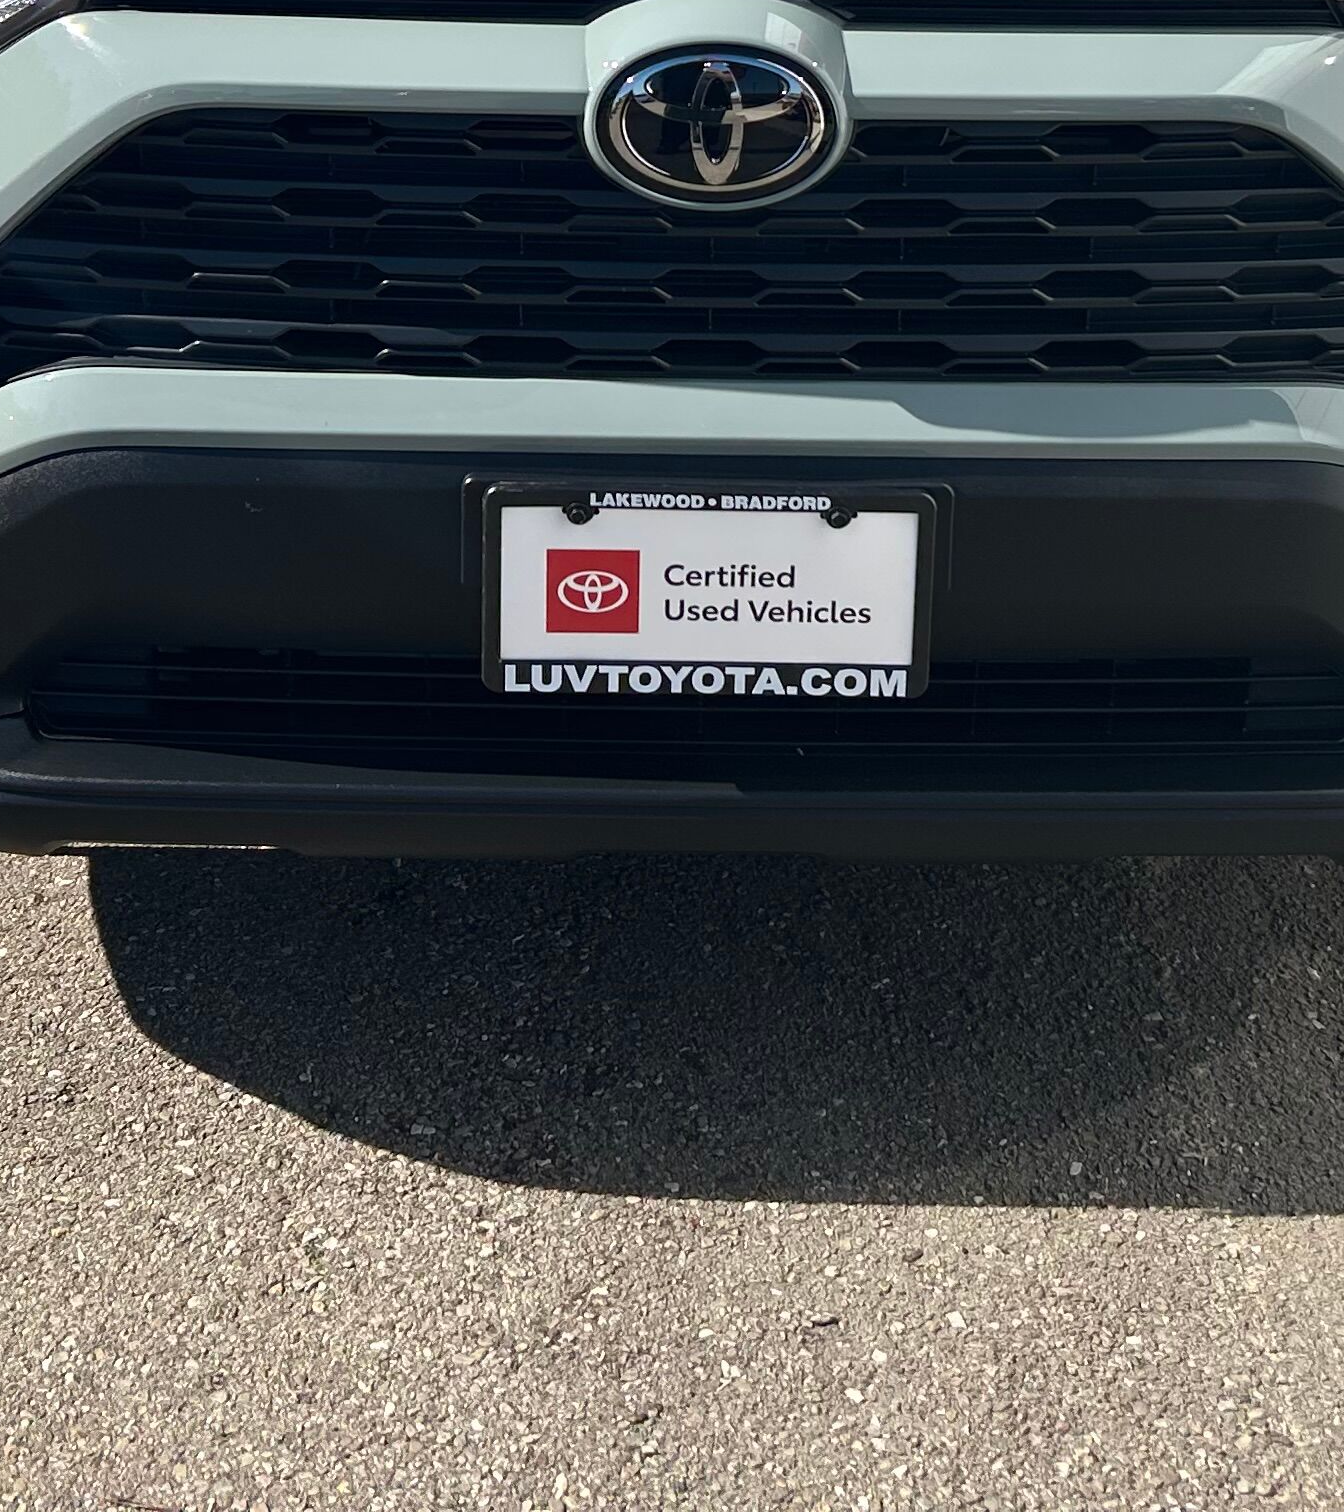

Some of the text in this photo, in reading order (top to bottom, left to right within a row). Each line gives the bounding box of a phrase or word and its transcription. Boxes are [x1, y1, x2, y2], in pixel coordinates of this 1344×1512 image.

[590, 492, 832, 512] LAKEWOOD BRADFORD
[663, 564, 796, 589] Certified
[664, 599, 872, 625] Used Vehicles
[503, 664, 907, 698] LUVTOYOTA.COM
